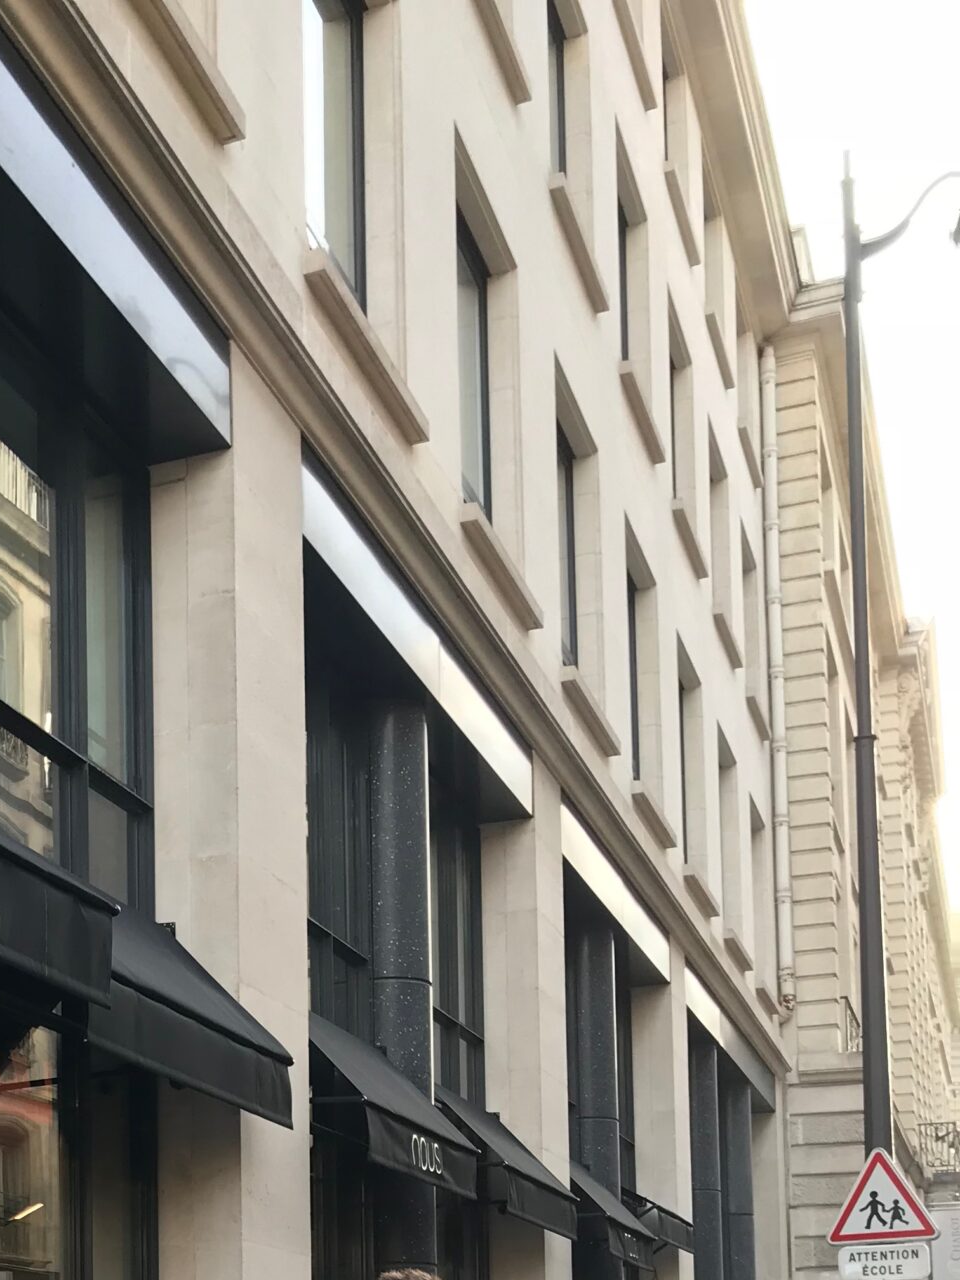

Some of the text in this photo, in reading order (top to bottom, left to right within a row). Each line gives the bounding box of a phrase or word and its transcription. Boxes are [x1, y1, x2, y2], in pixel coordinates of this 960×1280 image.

[411, 1133, 443, 1175] nous
[848, 1249, 919, 1262] ATTENTION
[862, 1264, 903, 1276] ÉCOLE
